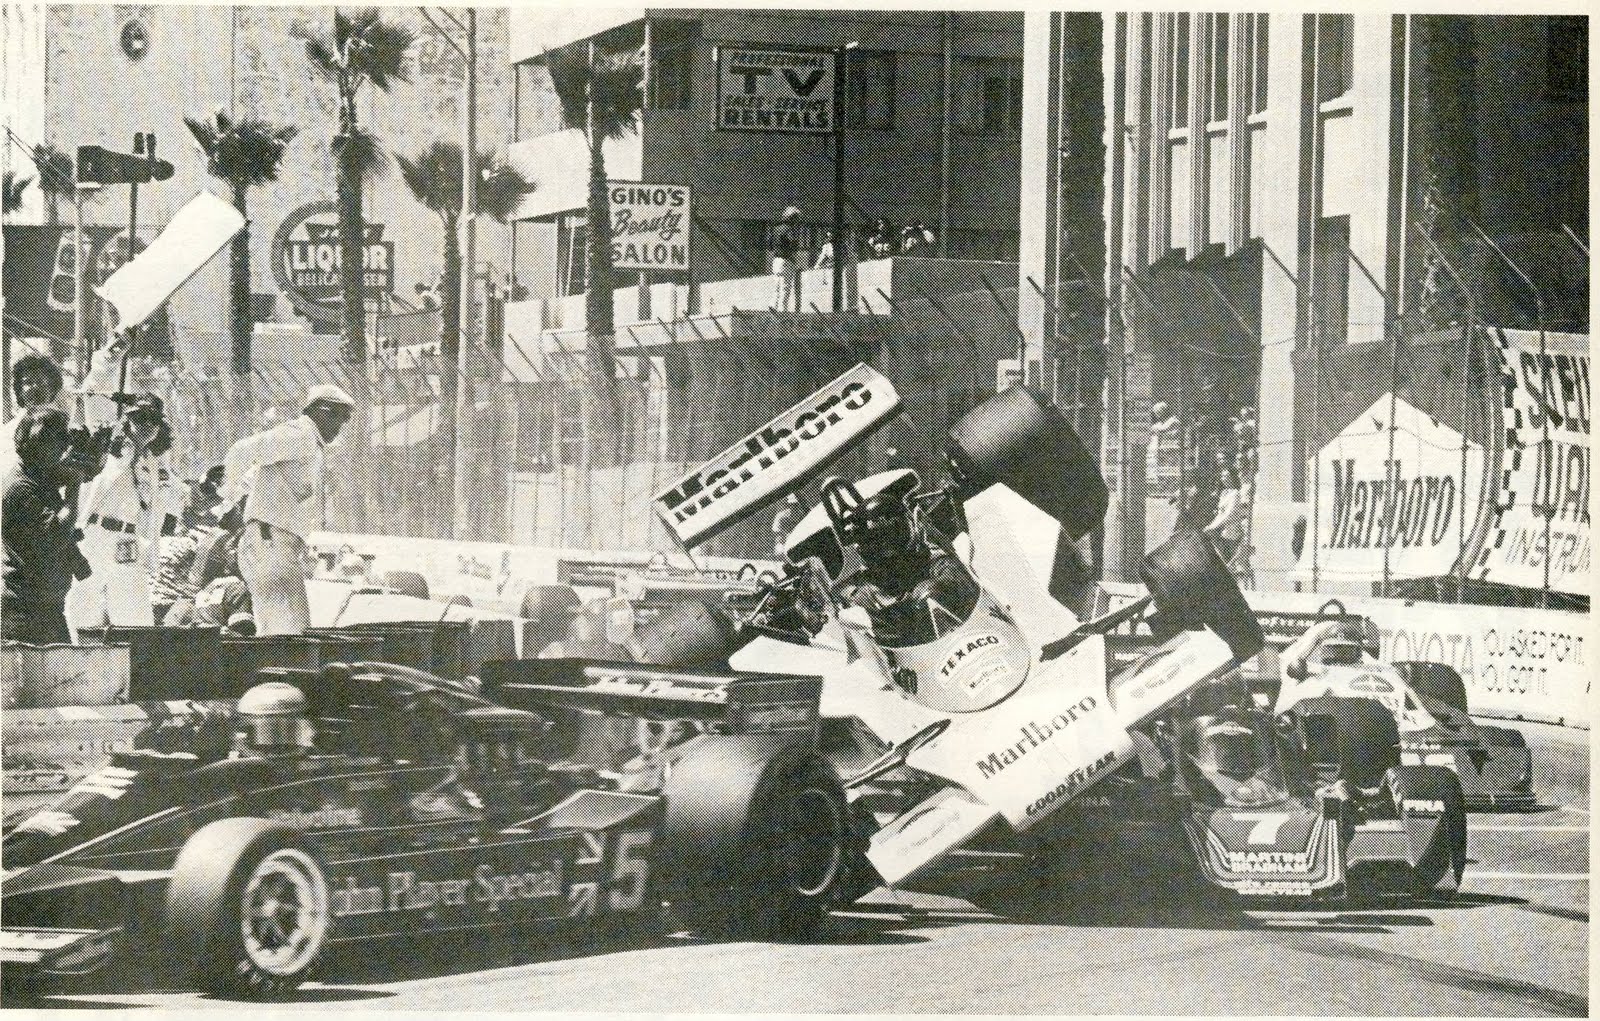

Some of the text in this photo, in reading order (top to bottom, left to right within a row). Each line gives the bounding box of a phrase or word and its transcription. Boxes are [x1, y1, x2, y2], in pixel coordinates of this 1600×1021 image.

[731, 51, 825, 68] PROFESSIONAL
[729, 65, 826, 98] TV
[724, 108, 829, 129] RENTALS
[611, 186, 684, 207] GINO'S
[611, 208, 682, 241] Beauty
[611, 242, 685, 265] SALON
[656, 382, 873, 524] Marlboro
[1328, 459, 1455, 549] Marlboro
[940, 635, 1000, 677] TEXACO
[1379, 628, 1475, 686] TOYOTA
[976, 695, 1097, 781] Marlboro
[1025, 750, 1117, 817] GOODYEAR
[1231, 811, 1291, 845] 7
[331, 876, 384, 917] ohn
[474, 859, 563, 912] Special
[608, 830, 652, 912] 5
